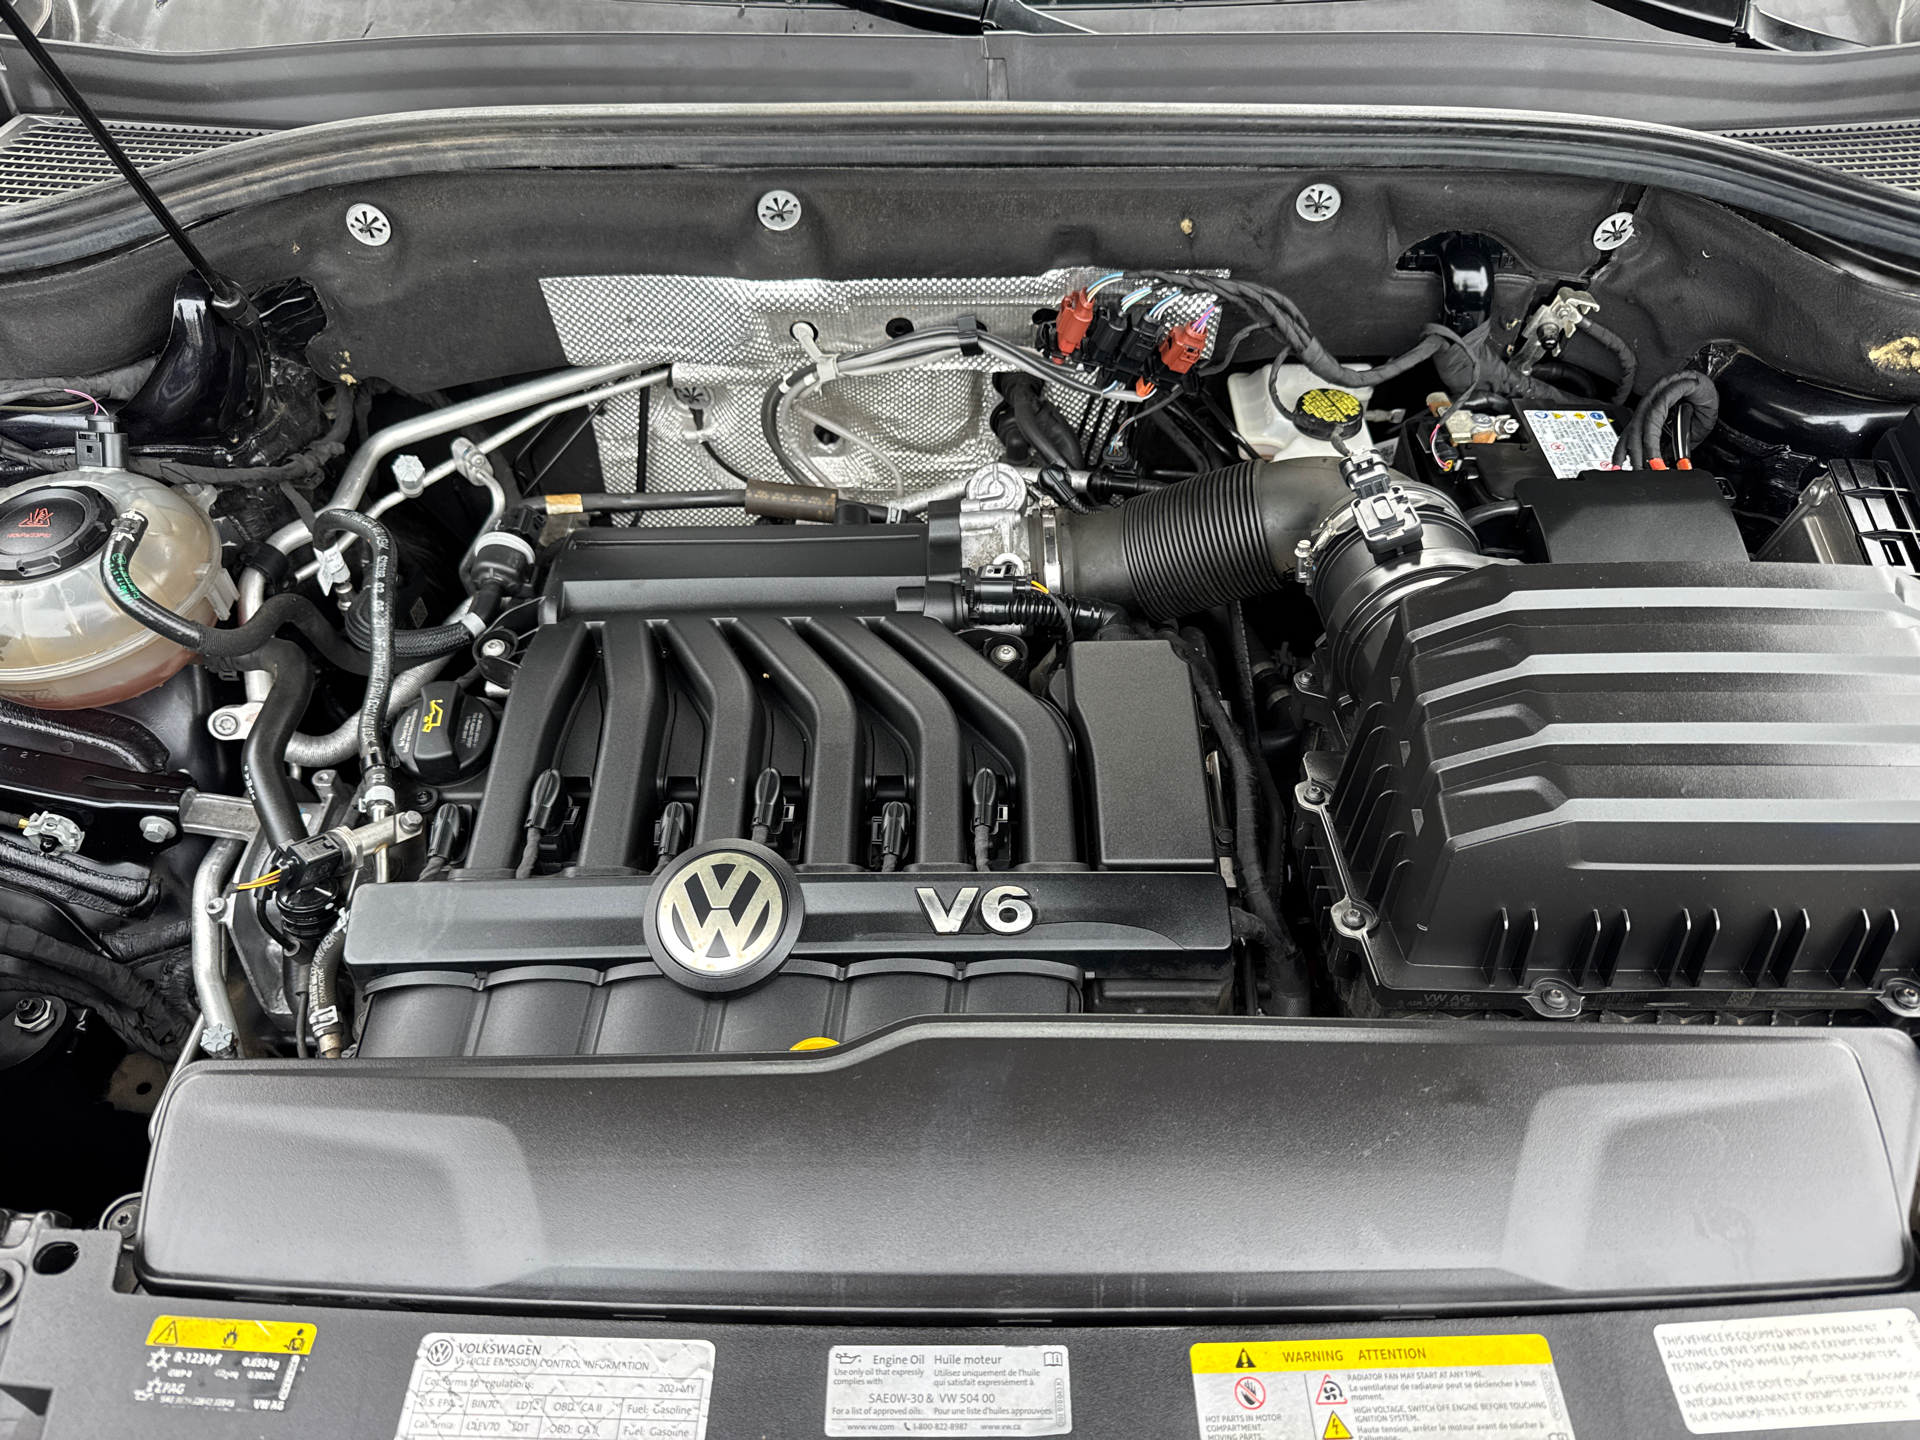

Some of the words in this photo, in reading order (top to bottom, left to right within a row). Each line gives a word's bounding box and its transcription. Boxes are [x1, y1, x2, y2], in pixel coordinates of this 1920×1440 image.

[915, 885, 1036, 935] V6
[1661, 1336, 1684, 1346] THIS
[1684, 1332, 1724, 1345] VEHICLE
[1725, 1332, 1735, 1342] IS
[459, 1343, 542, 1355] VOLKSWAGEN
[1720, 1345, 1749, 1356] DRIVE
[173, 1351, 223, 1366] R-1234yf
[268, 1358, 280, 1370] kg
[1282, 1350, 1344, 1363] WARNING
[1358, 1347, 1427, 1360] ATTENTION
[873, 1355, 908, 1367] Engine
[910, 1355, 925, 1364] Oil
[934, 1355, 961, 1364] Huile
[964, 1356, 1002, 1364] moteur
[1671, 1361, 1712, 1372] TESTING
[1713, 1360, 1728, 1370] ON
[849, 1368, 864, 1377] only
[892, 1369, 924, 1377] expressly
[962, 1369, 1006, 1378] uniquement
[1347, 1373, 1383, 1381] RADIATOR
[1384, 1372, 1398, 1380] FAN
[470, 1378, 479, 1387] to
[834, 1378, 865, 1386] complies
[934, 1379, 945, 1387] qui
[977, 1379, 1028, 1388] expressément
[1359, 1383, 1399, 1391] ventilateur
[1411, 1382, 1444, 1390] radiateur
[1474, 1380, 1513, 1388] déclencher
[1679, 1384, 1691, 1395] CE
[1740, 1380, 1755, 1391] EST
[869, 1393, 924, 1403] SAE0W-30
[926, 1394, 934, 1403] &
[939, 1393, 957, 1403] VW
[960, 1393, 979, 1403] 504
[982, 1393, 995, 1403] 00
[1351, 1393, 1384, 1401] moment.
[254, 1399, 270, 1410] VW
[271, 1401, 285, 1411] AG
[582, 1403, 594, 1412] CA
[628, 1405, 648, 1414] Fuel:
[653, 1405, 692, 1415] Gasoline
[1353, 1406, 1371, 1414] HIGH
[1373, 1405, 1406, 1413] VOLTAGE,
[1452, 1403, 1479, 1411] ENGINE
[1480, 1402, 1508, 1410] BEFORE
[1510, 1401, 1547, 1409] TOUCHING
[832, 1407, 843, 1415] For
[852, 1407, 863, 1415] list
[864, 1407, 872, 1415] of
[873, 1407, 907, 1416] approved
[909, 1407, 924, 1415] oils:
[934, 1407, 949, 1415] Pour
[967, 1407, 981, 1415] liste
[983, 1407, 1009, 1415] d'huiles
[1689, 1412, 1708, 1422] SUR
[1205, 1415, 1220, 1423] HOT
[1222, 1414, 1244, 1422] PARTS
[1246, 1414, 1254, 1422] IN
[1256, 1414, 1282, 1422] MOTOR
[1355, 1415, 1387, 1423] IGNITION
[650, 1427, 689, 1437] Gasoline
[913, 1423, 968, 1431] 1-800-822-8987
[1207, 1424, 1264, 1432] COMPARTMENT.
[1357, 1426, 1379, 1434] Haute
[1381, 1425, 1411, 1433] tension,
[1413, 1424, 1437, 1432] arrêter
[1448, 1423, 1474, 1431] moteur
